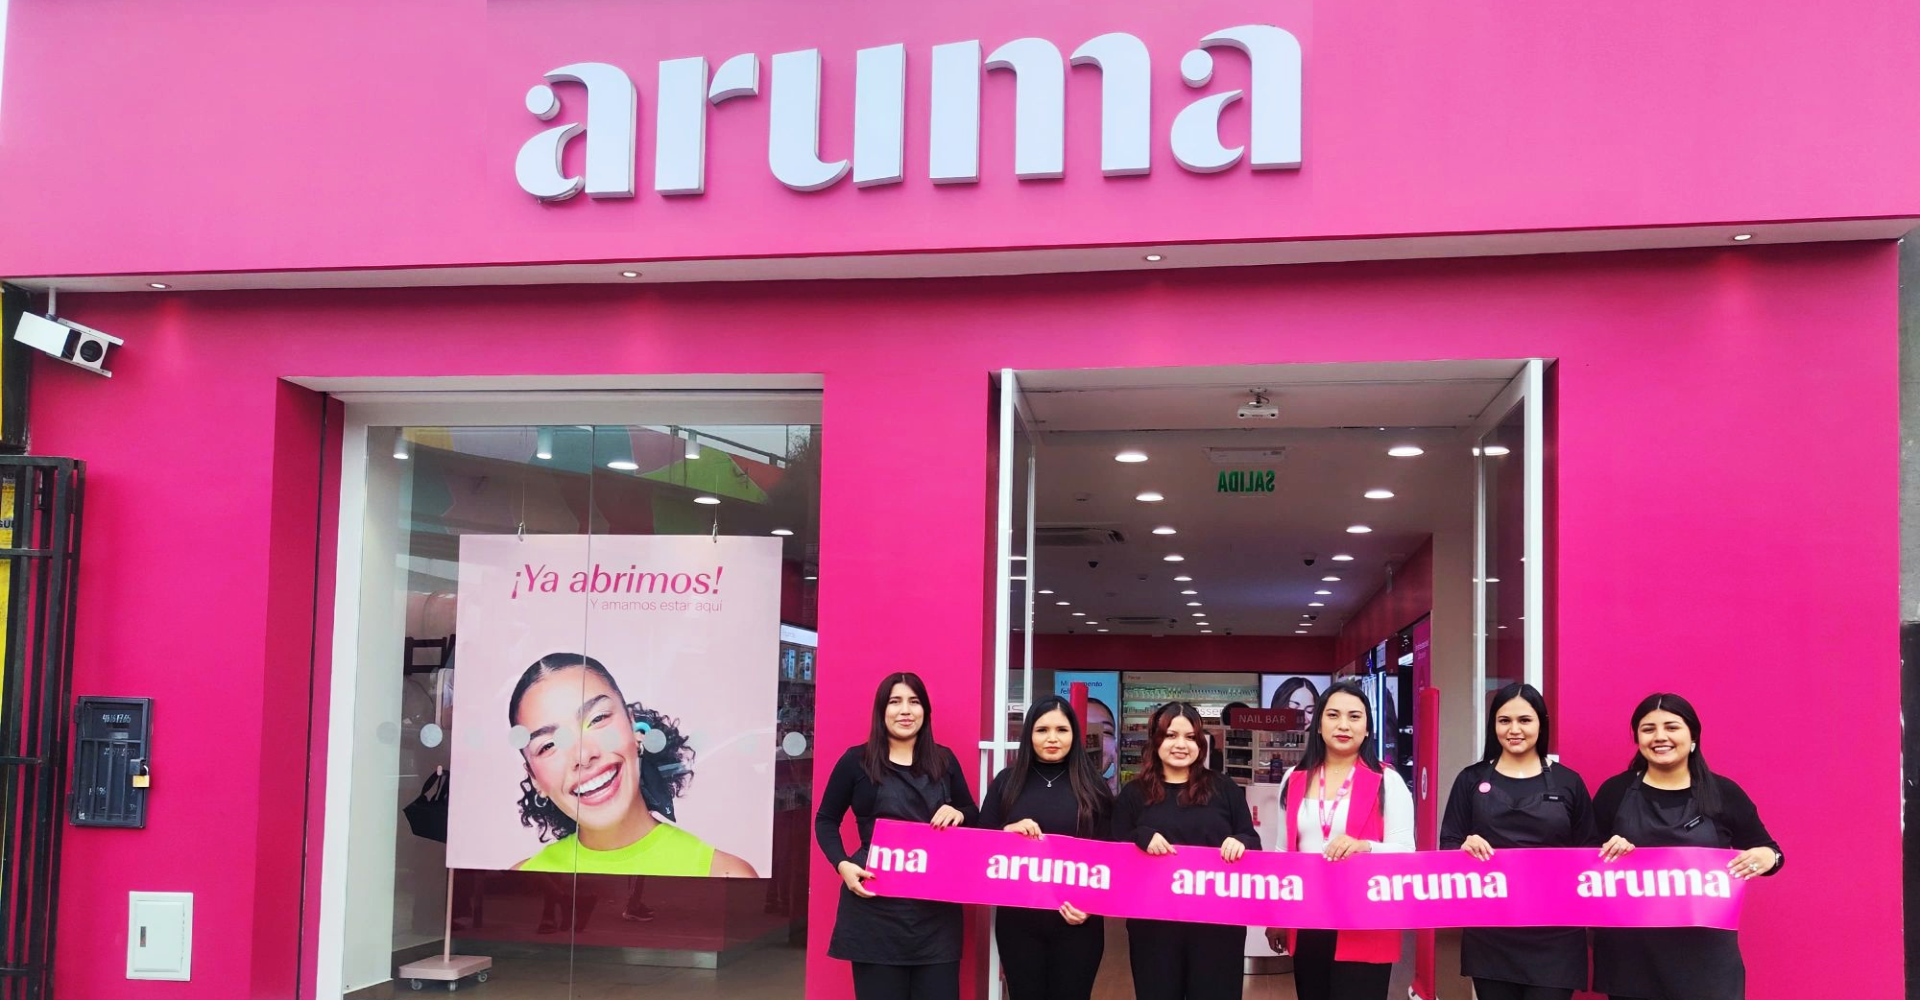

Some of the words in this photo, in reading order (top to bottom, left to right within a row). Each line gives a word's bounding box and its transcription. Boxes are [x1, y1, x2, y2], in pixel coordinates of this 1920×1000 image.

[515, 24, 1302, 201] aruma
[511, 563, 559, 599] ¡Ya
[569, 563, 723, 595] abrimos!
[590, 598, 598, 609] Y
[601, 600, 657, 611] amamos
[660, 600, 691, 611] estar
[1239, 715, 1262, 724] NAIL
[1265, 715, 1286, 724] BAR
[986, 854, 1111, 890] aruma
[1171, 868, 1304, 901] aruma
[1366, 871, 1508, 902] aruma
[1576, 868, 1732, 898] aruma
